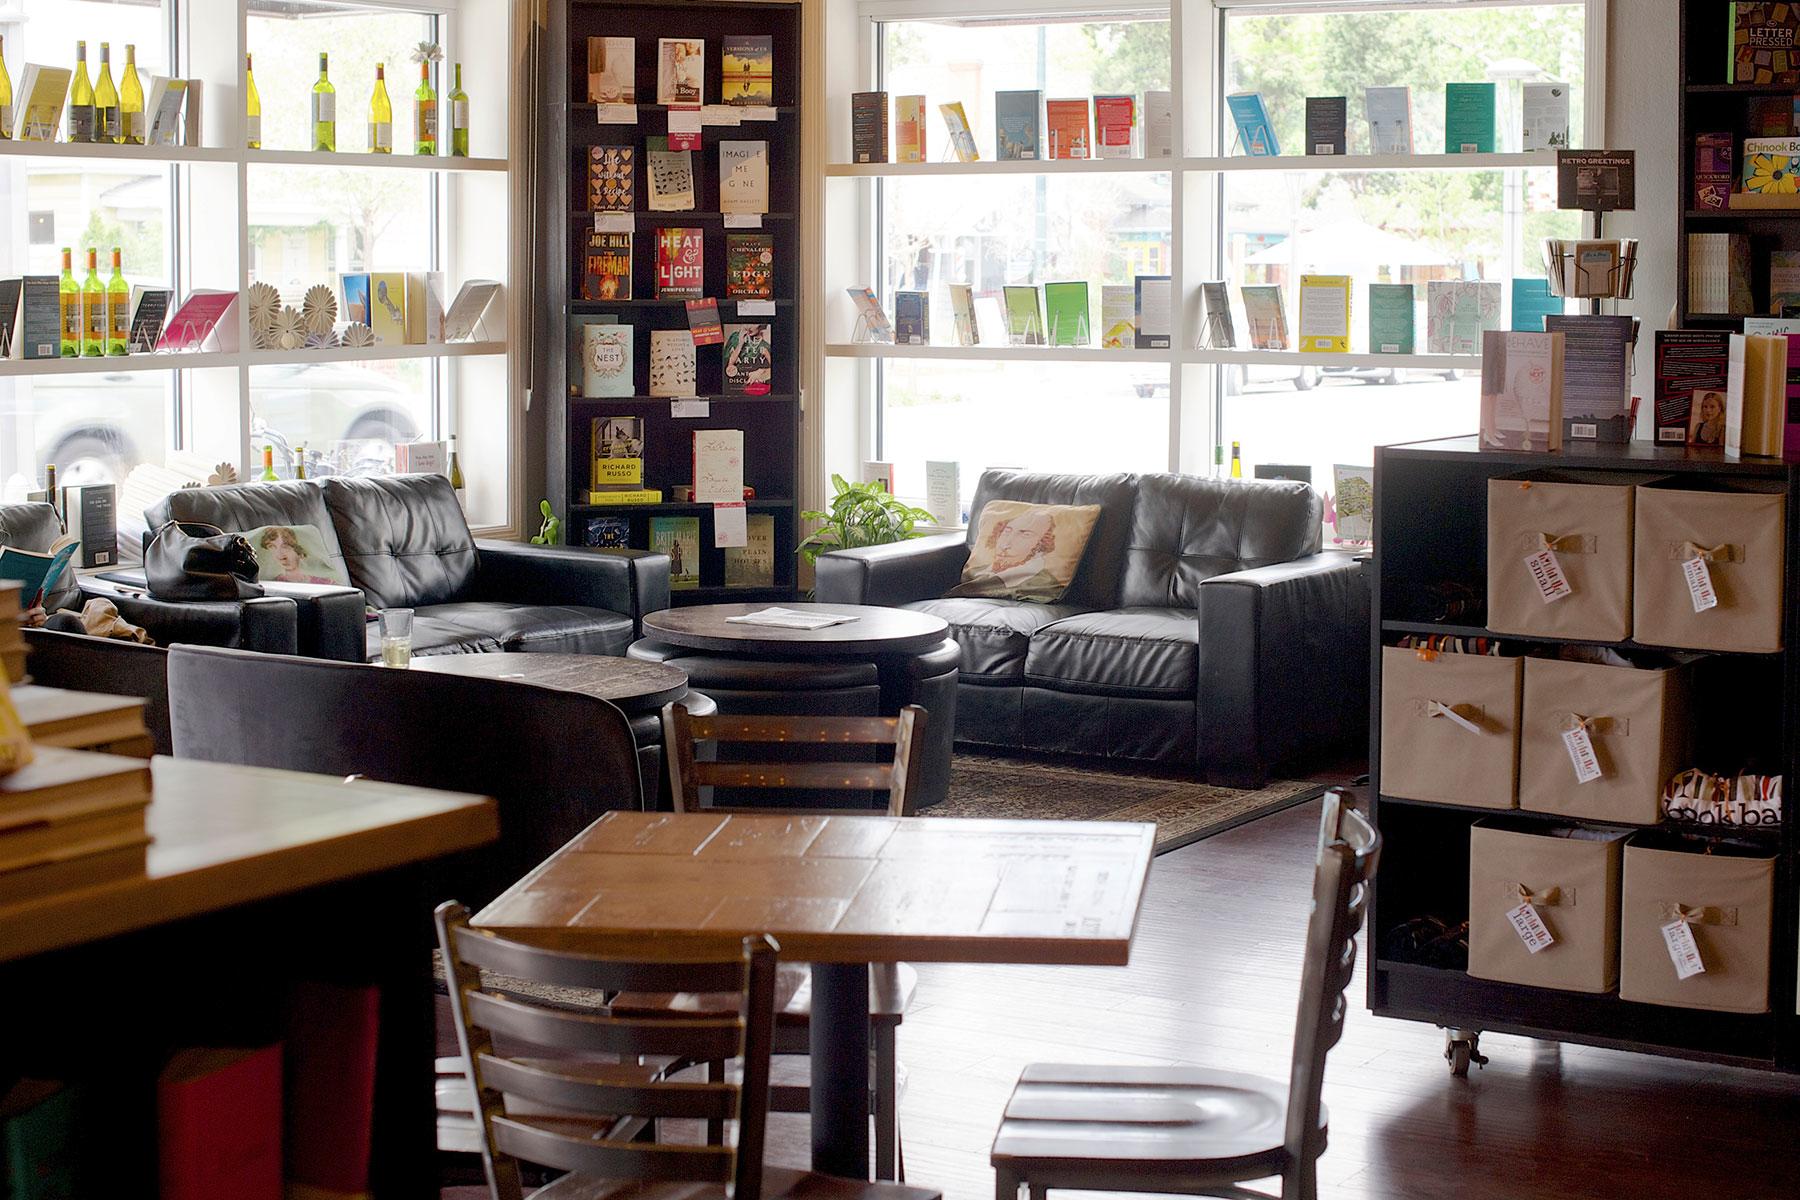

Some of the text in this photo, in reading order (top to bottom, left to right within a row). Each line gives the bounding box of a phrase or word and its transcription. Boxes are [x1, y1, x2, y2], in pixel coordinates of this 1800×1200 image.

[1750, 28, 1792, 38] LETTER
[1750, 38, 1792, 46] PRESSED
[1746, 142, 1788, 152] Chinook
[589, 234, 630, 248] JOE HILL
[660, 235, 702, 248] HEAT
[682, 248, 699, 264] &
[588, 256, 630, 276] FIREMAN
[660, 263, 702, 285] LIGHT
[732, 270, 771, 278] EDGE
[596, 354, 620, 362] NEST
[1530, 560, 1556, 597] small
[1512, 913, 1537, 946] large
